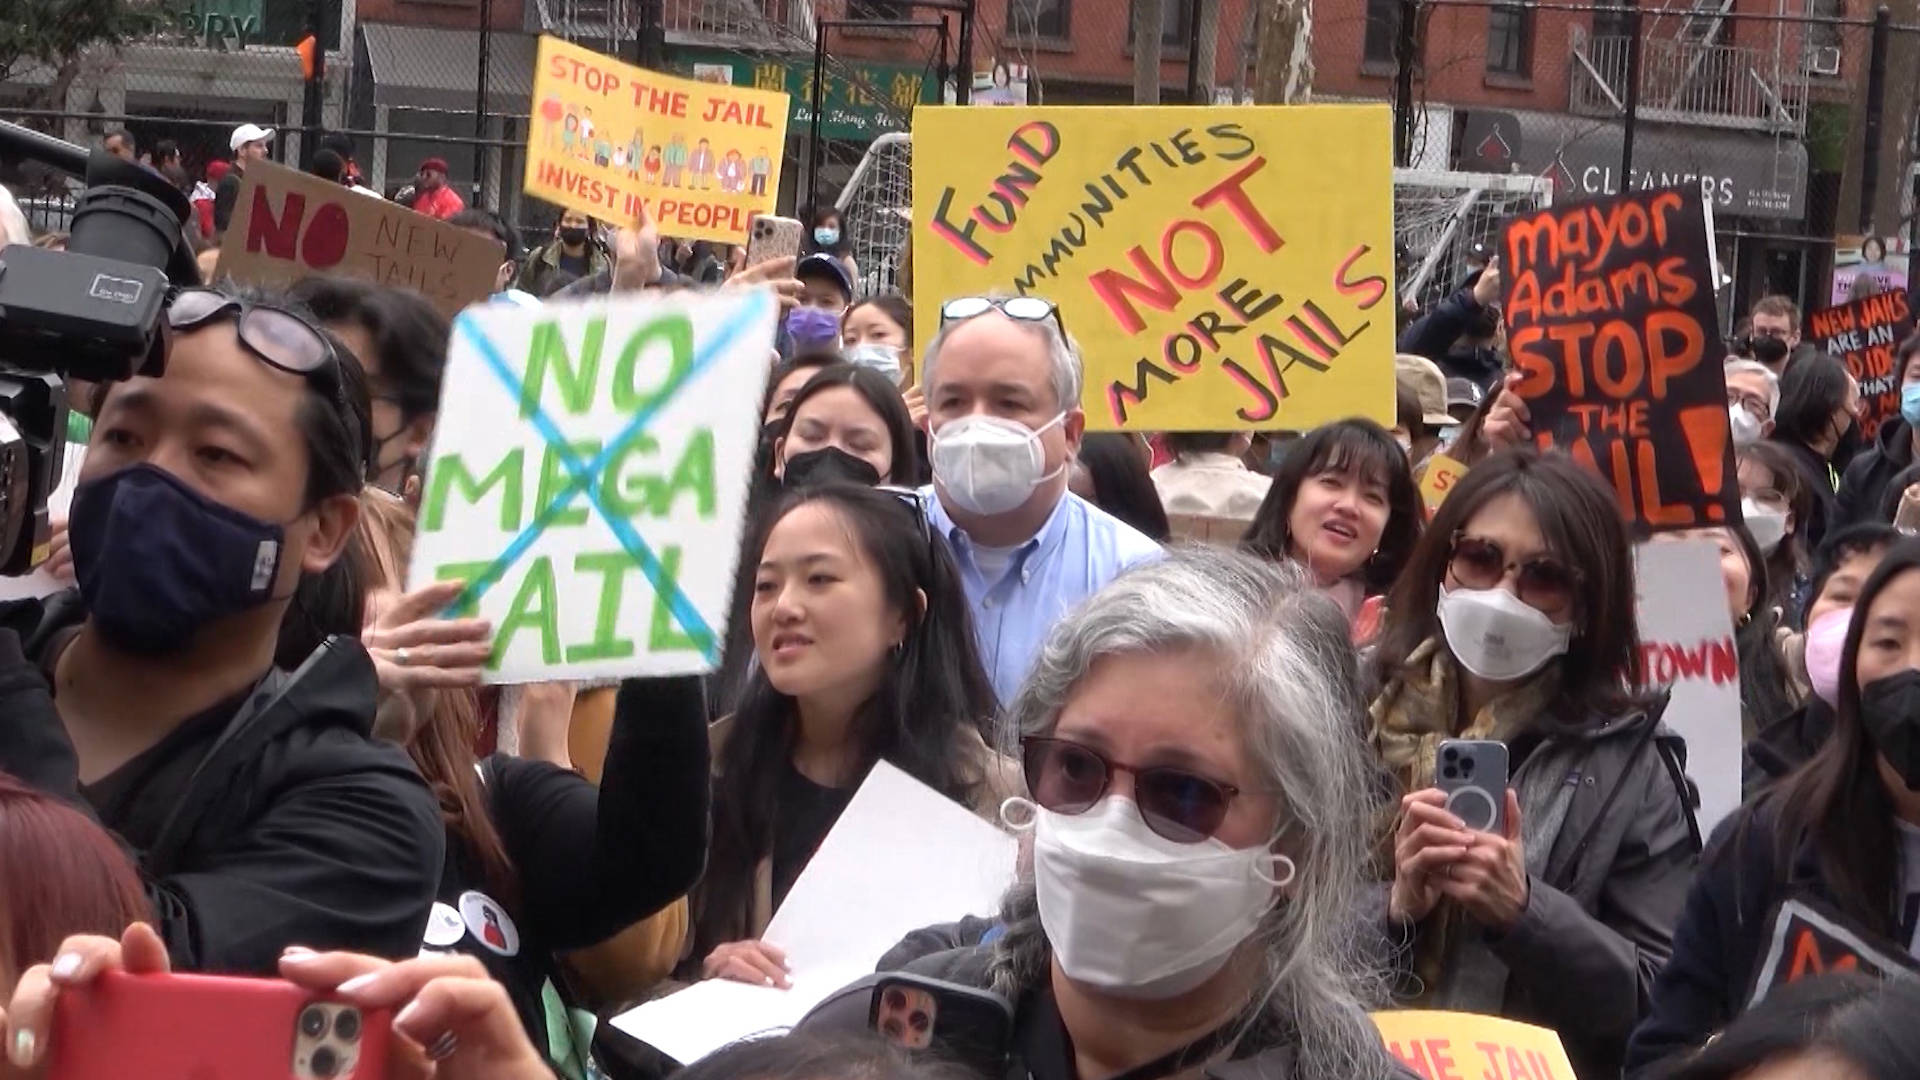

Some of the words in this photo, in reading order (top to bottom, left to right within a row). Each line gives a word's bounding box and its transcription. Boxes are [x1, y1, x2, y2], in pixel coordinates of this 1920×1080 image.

[549, 54, 620, 97] STOP
[630, 81, 691, 119] THE
[702, 97, 773, 129] JAIL
[246, 184, 350, 270] NO
[536, 158, 620, 210] INVEST
[624, 192, 651, 217] IN
[930, 120, 1062, 266] FUND
[1013, 123, 1256, 297] MMUNITIES
[1088, 156, 1287, 336] NOT
[1221, 244, 1388, 423] JAILS
[1507, 256, 1697, 328] Adams
[1811, 305, 1857, 339] NEW
[1859, 289, 1910, 329] JAILS
[519, 314, 695, 420] NO
[1106, 278, 1284, 427] MORE
[1510, 309, 1705, 400] STOP
[1827, 329, 1862, 356] ARE
[1867, 324, 1895, 347] AN
[1568, 401, 1650, 437] THE
[421, 425, 717, 532] MEGA
[435, 545, 714, 670] JAIL
[1632, 634, 1737, 685] TOWN
[1388, 1039, 1465, 1080] HE
